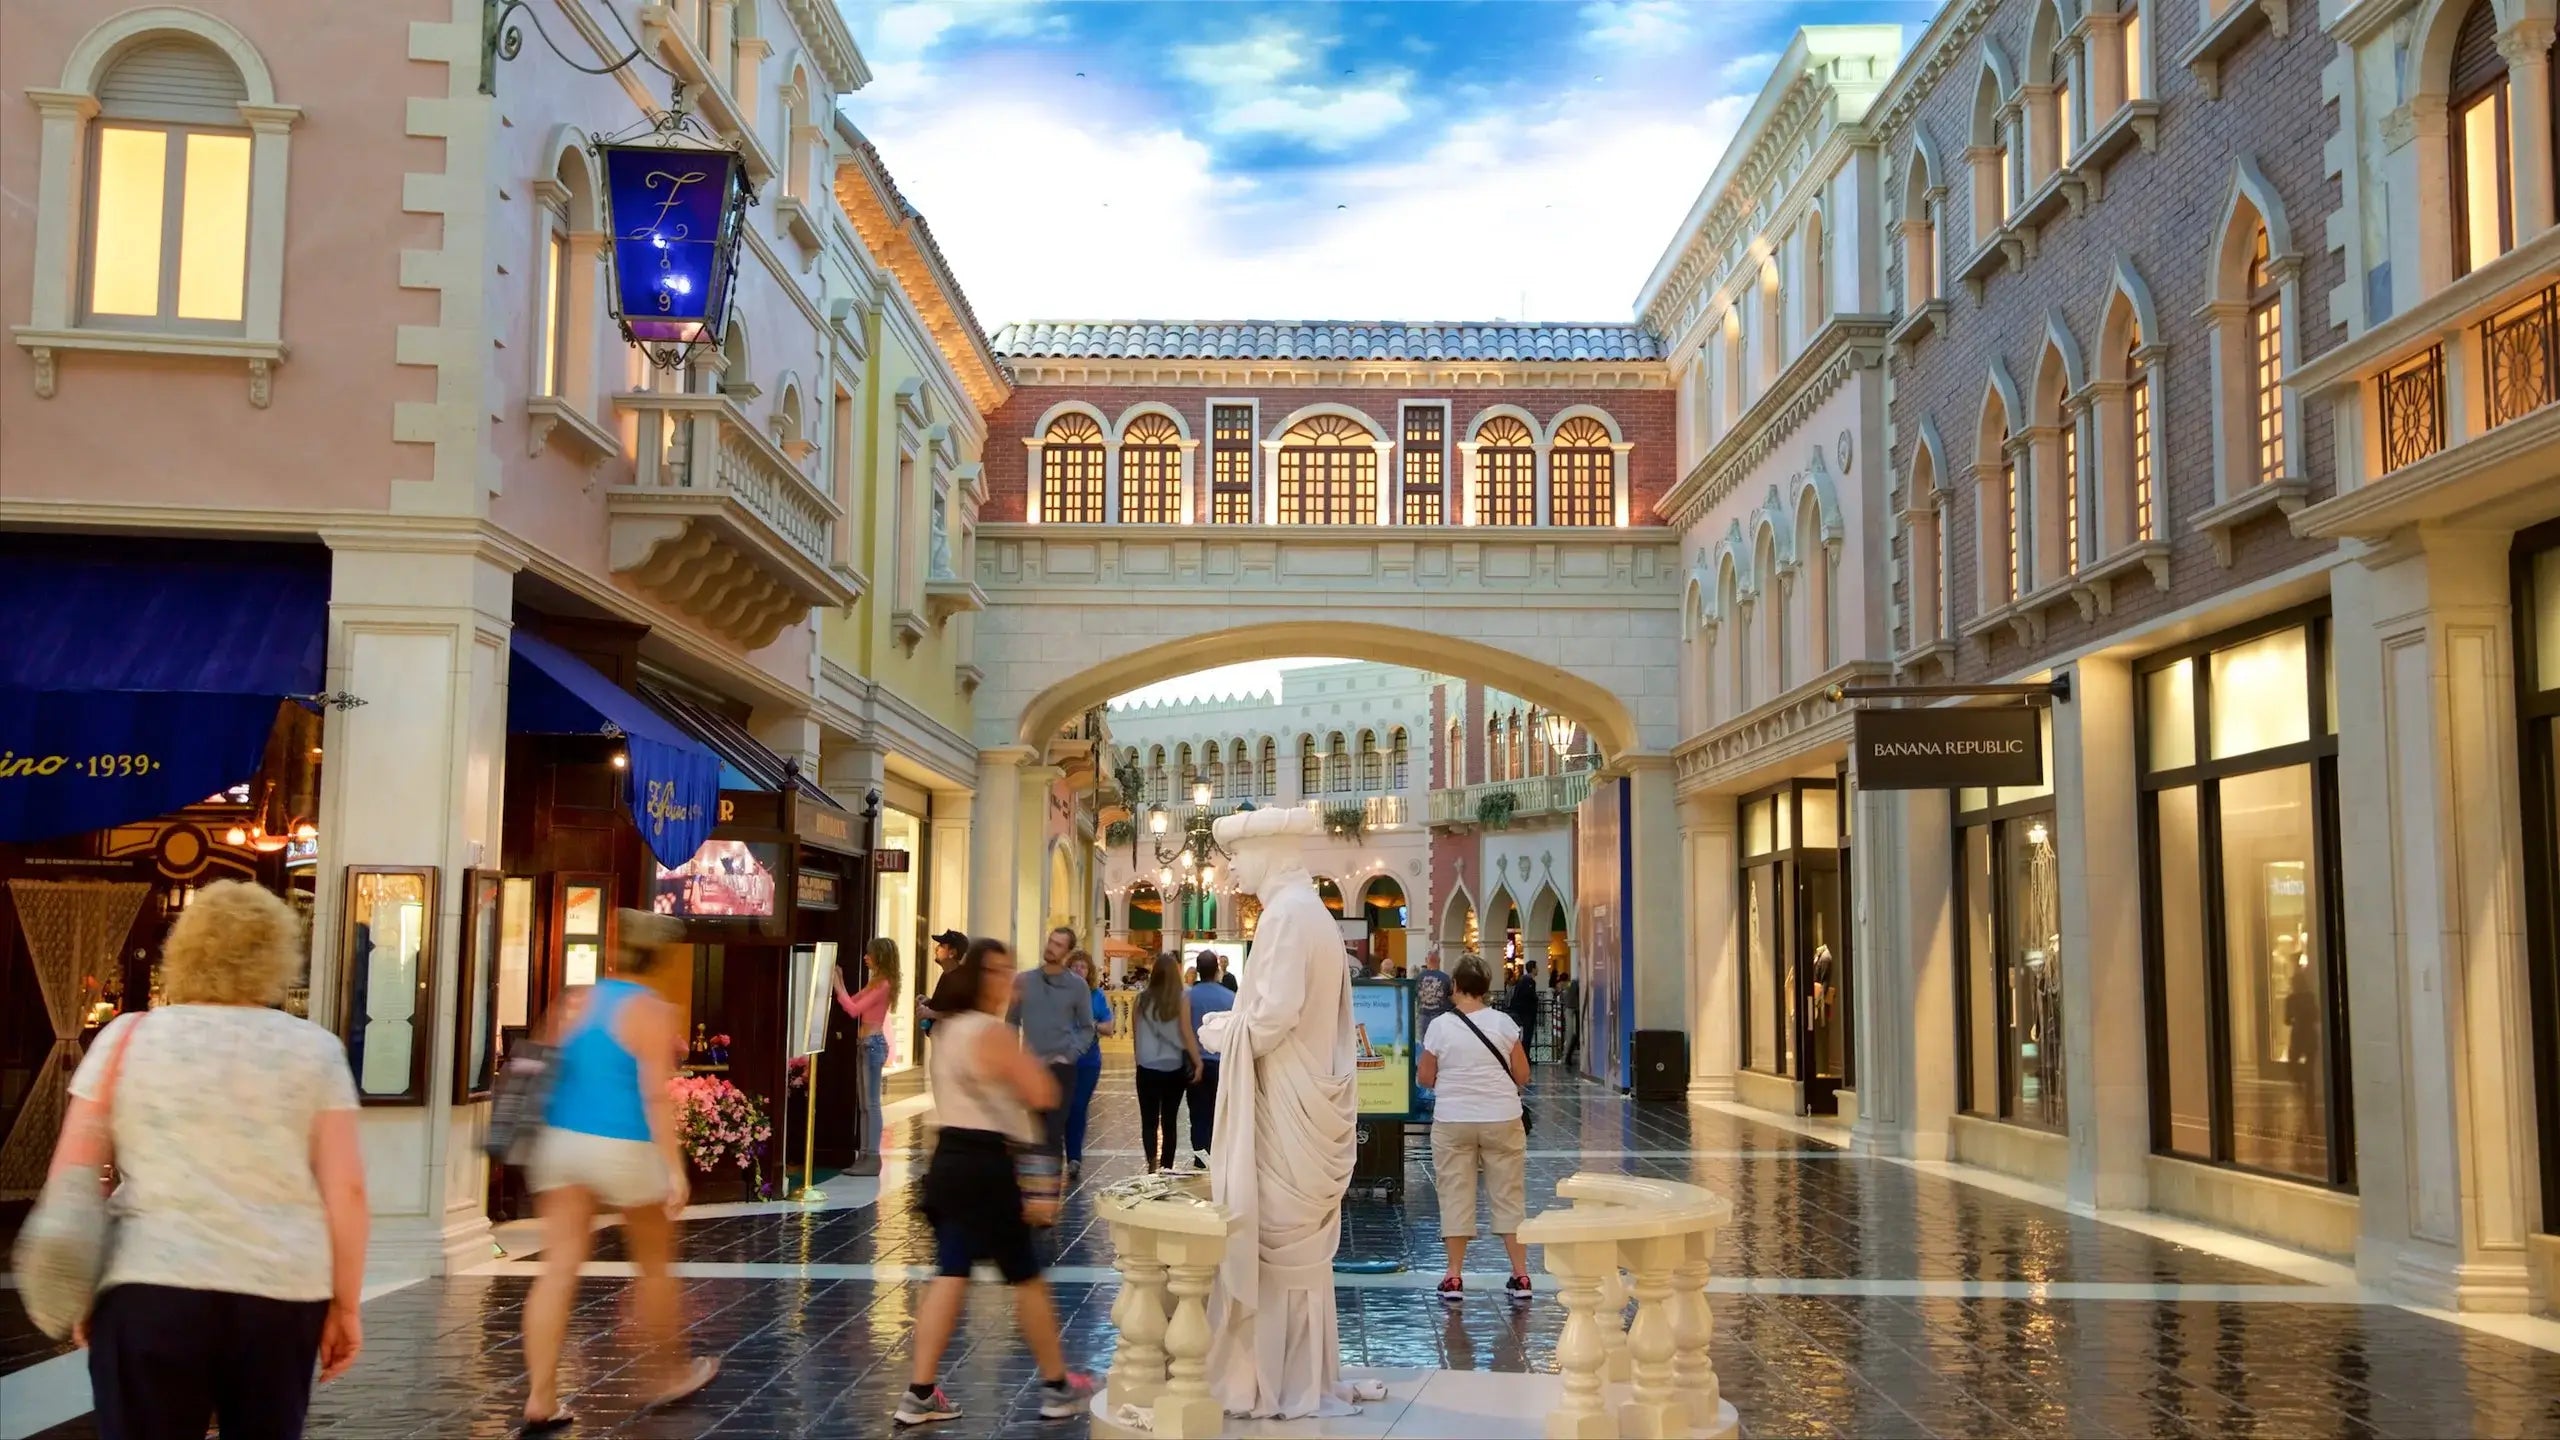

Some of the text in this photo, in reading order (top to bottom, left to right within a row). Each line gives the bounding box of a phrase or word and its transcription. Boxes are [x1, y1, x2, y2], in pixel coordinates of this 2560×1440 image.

[1874, 739, 2024, 757] BANANA REPUBLIC
[875, 850, 901, 869] EXIT
